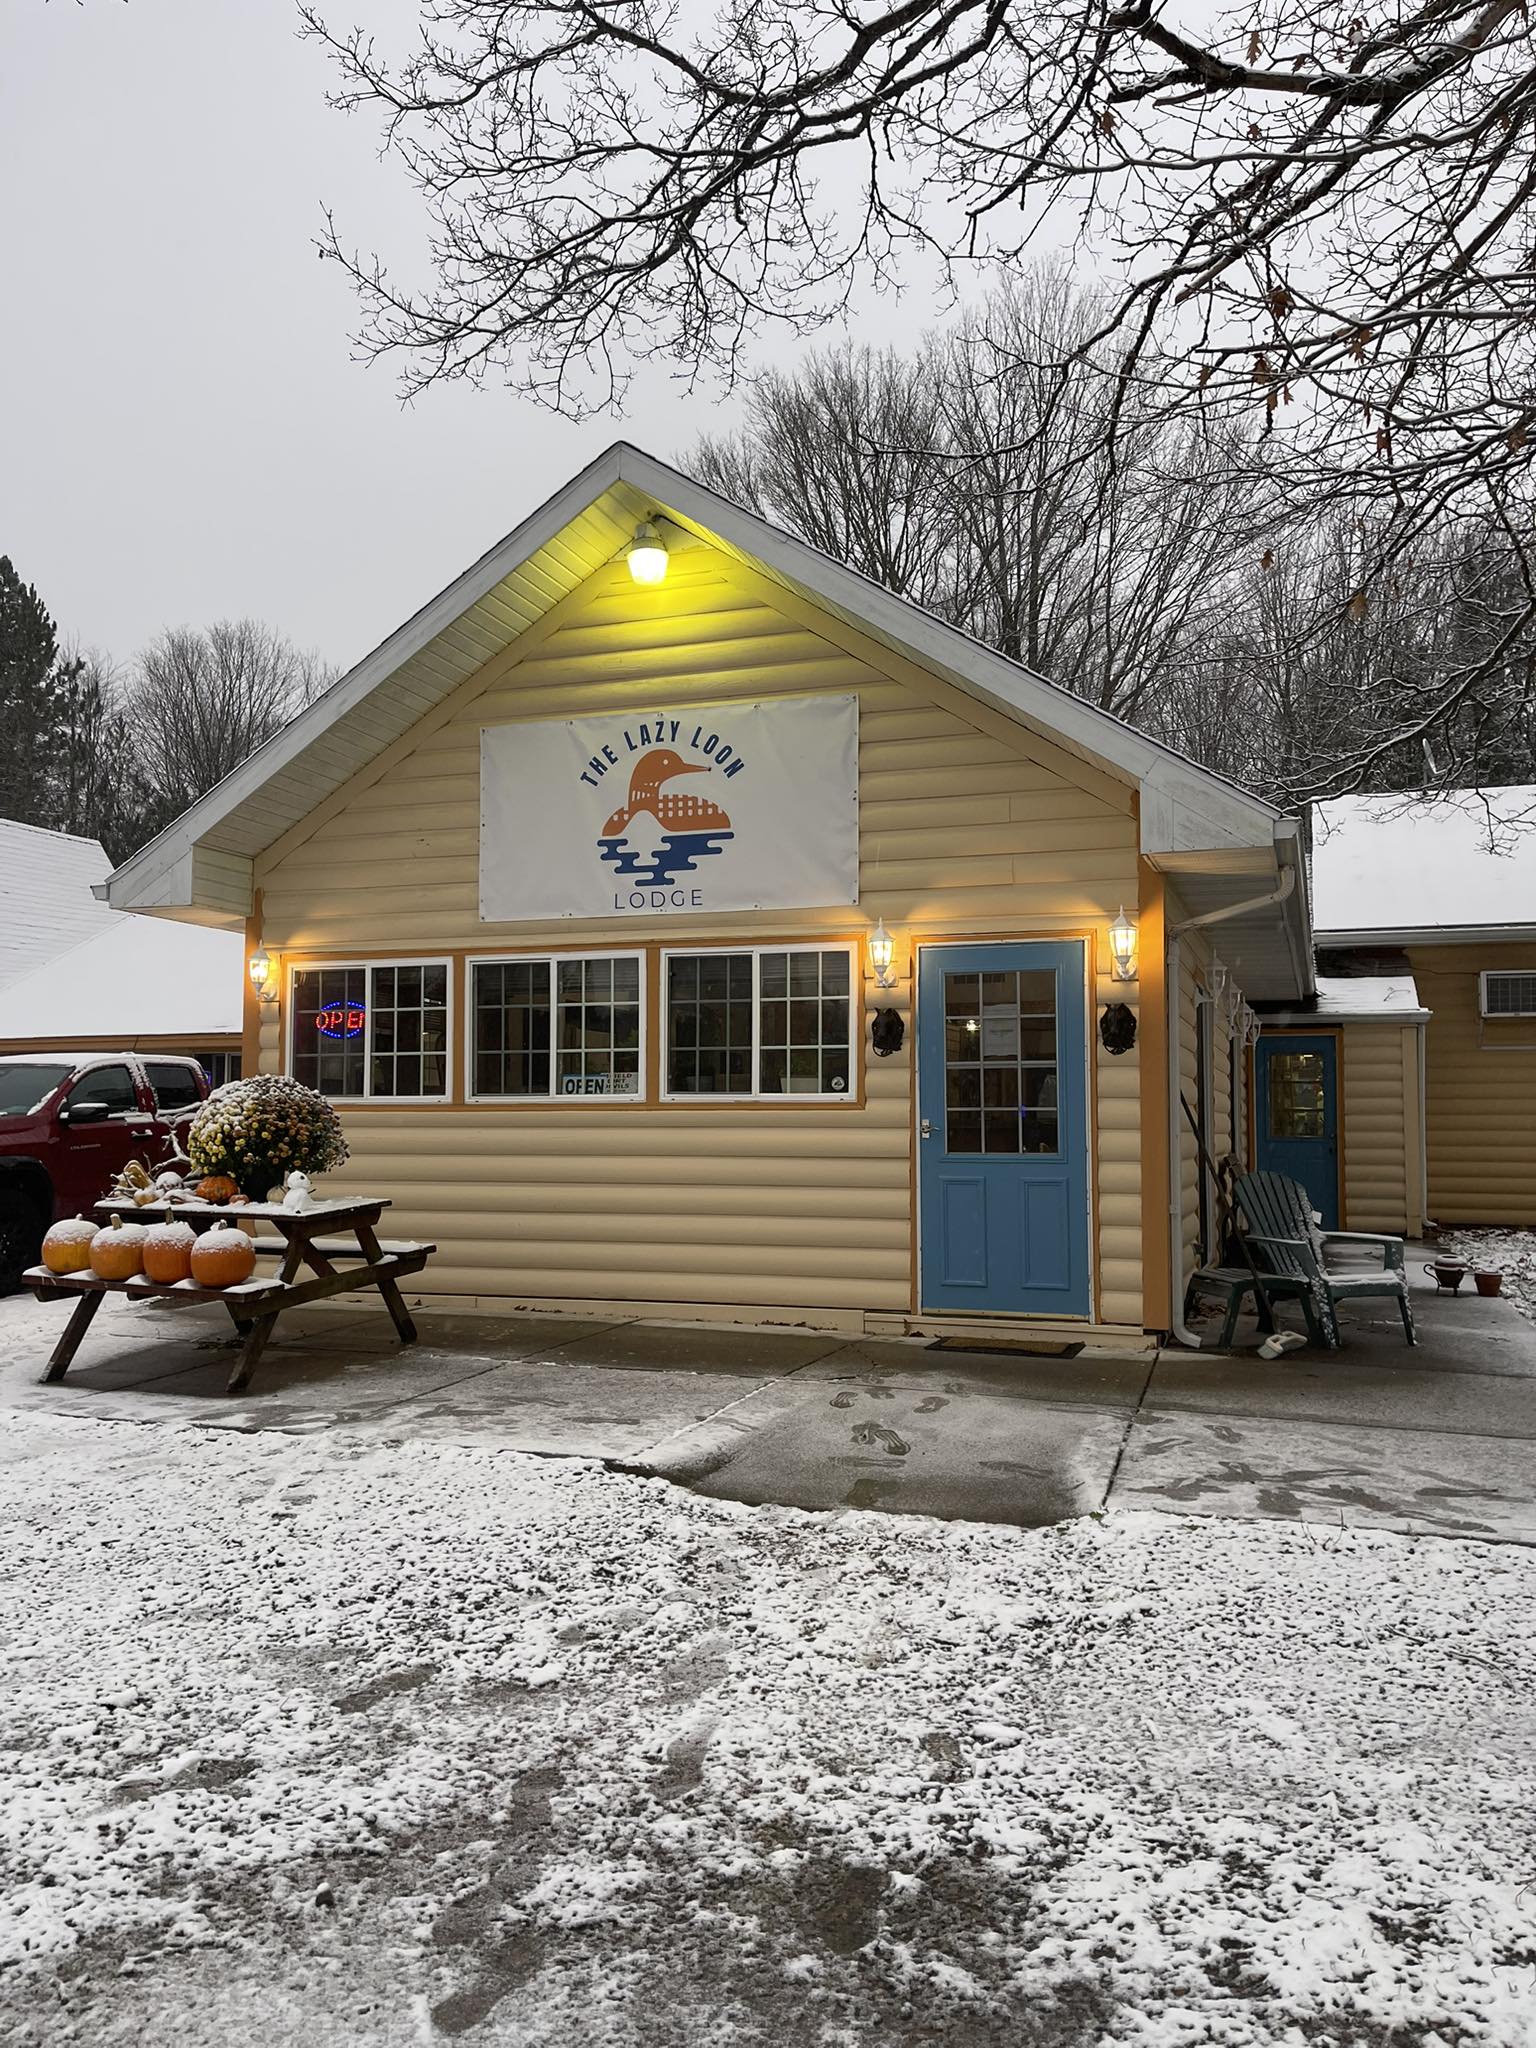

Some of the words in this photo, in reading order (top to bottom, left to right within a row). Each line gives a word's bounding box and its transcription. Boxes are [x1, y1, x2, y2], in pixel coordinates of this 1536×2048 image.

[580, 744, 619, 787] THE
[623, 720, 680, 751] LAZY
[690, 726, 745, 779] LOON
[614, 889, 703, 909] LODGE
[565, 1079, 604, 1094] OPEN
